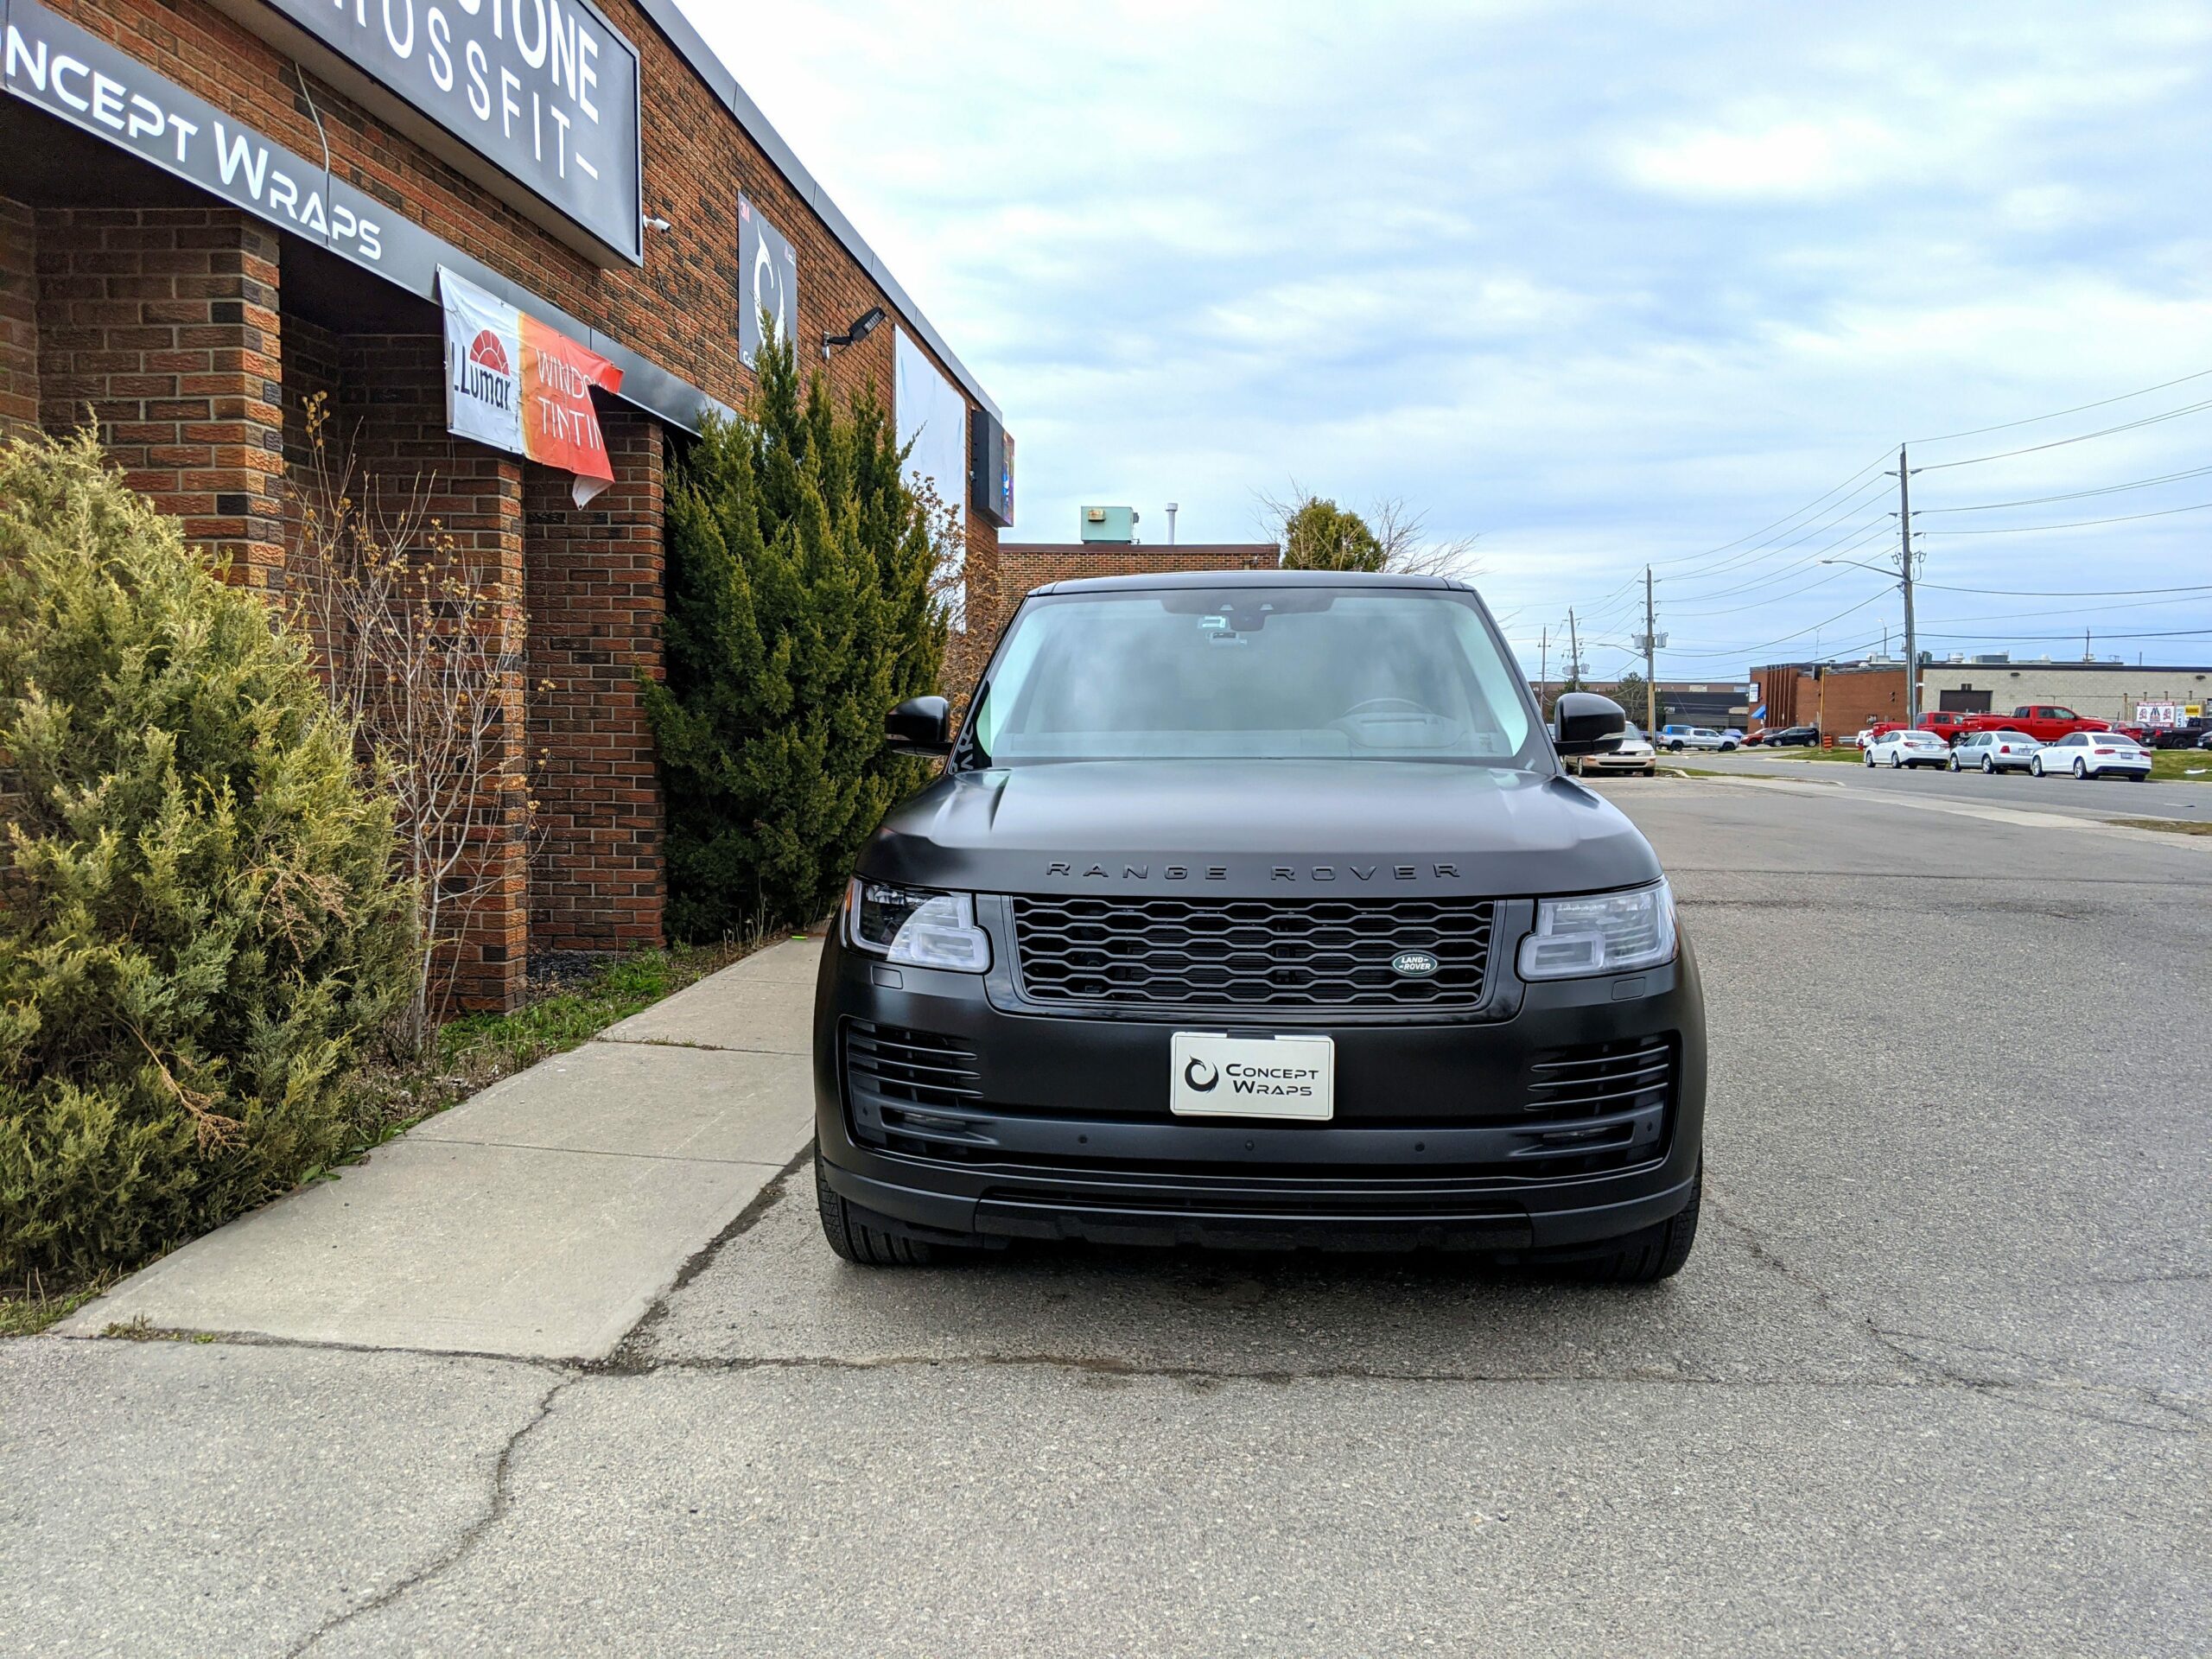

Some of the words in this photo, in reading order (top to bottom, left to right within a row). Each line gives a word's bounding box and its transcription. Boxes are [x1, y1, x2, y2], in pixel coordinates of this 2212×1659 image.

[0, 25, 199, 162] NCEPT
[213, 120, 381, 260] WRAPS
[536, 347, 607, 401] WINDO
[1046, 861, 1227, 880] RANGE
[1271, 863, 1460, 880] ROVER
[1226, 1064, 1319, 1079] CONCEPT
[1233, 1080, 1312, 1096] WRAPS
